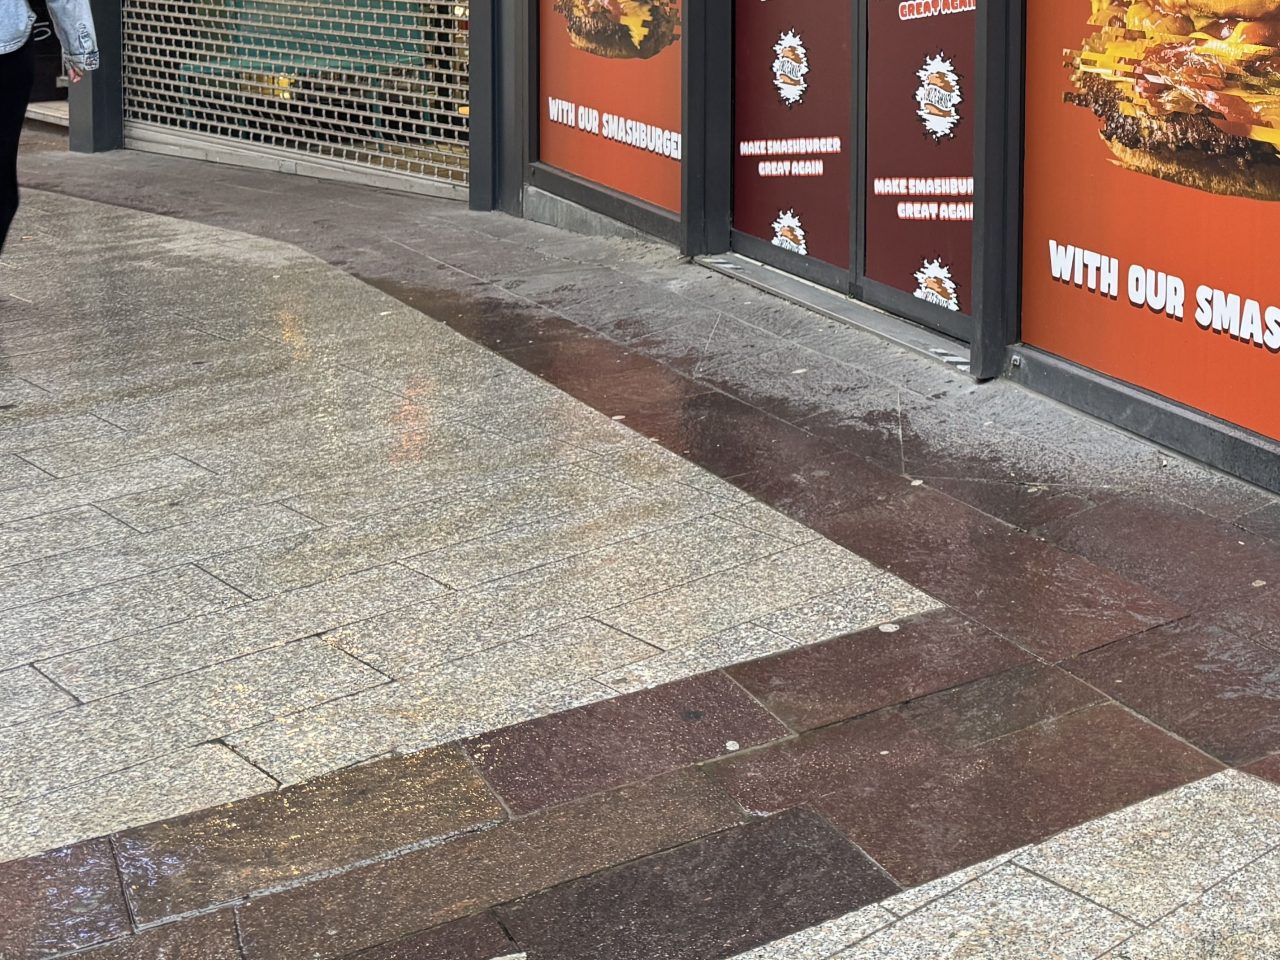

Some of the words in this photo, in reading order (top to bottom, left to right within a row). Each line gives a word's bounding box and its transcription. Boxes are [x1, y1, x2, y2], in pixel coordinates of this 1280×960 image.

[548, 96, 576, 128] WITH
[577, 105, 600, 136] OUR
[739, 140, 768, 157] MAKE
[767, 136, 842, 156] SMASHBURGER
[758, 161, 791, 177] GREAT
[791, 160, 824, 176] AGAIN
[874, 178, 909, 196] MAKE
[908, 177, 974, 196] SMASHBUR
[897, 202, 940, 221] GREAT
[939, 202, 974, 221] AGAI
[1048, 239, 1119, 300] WITH
[1127, 264, 1186, 321] OUR
